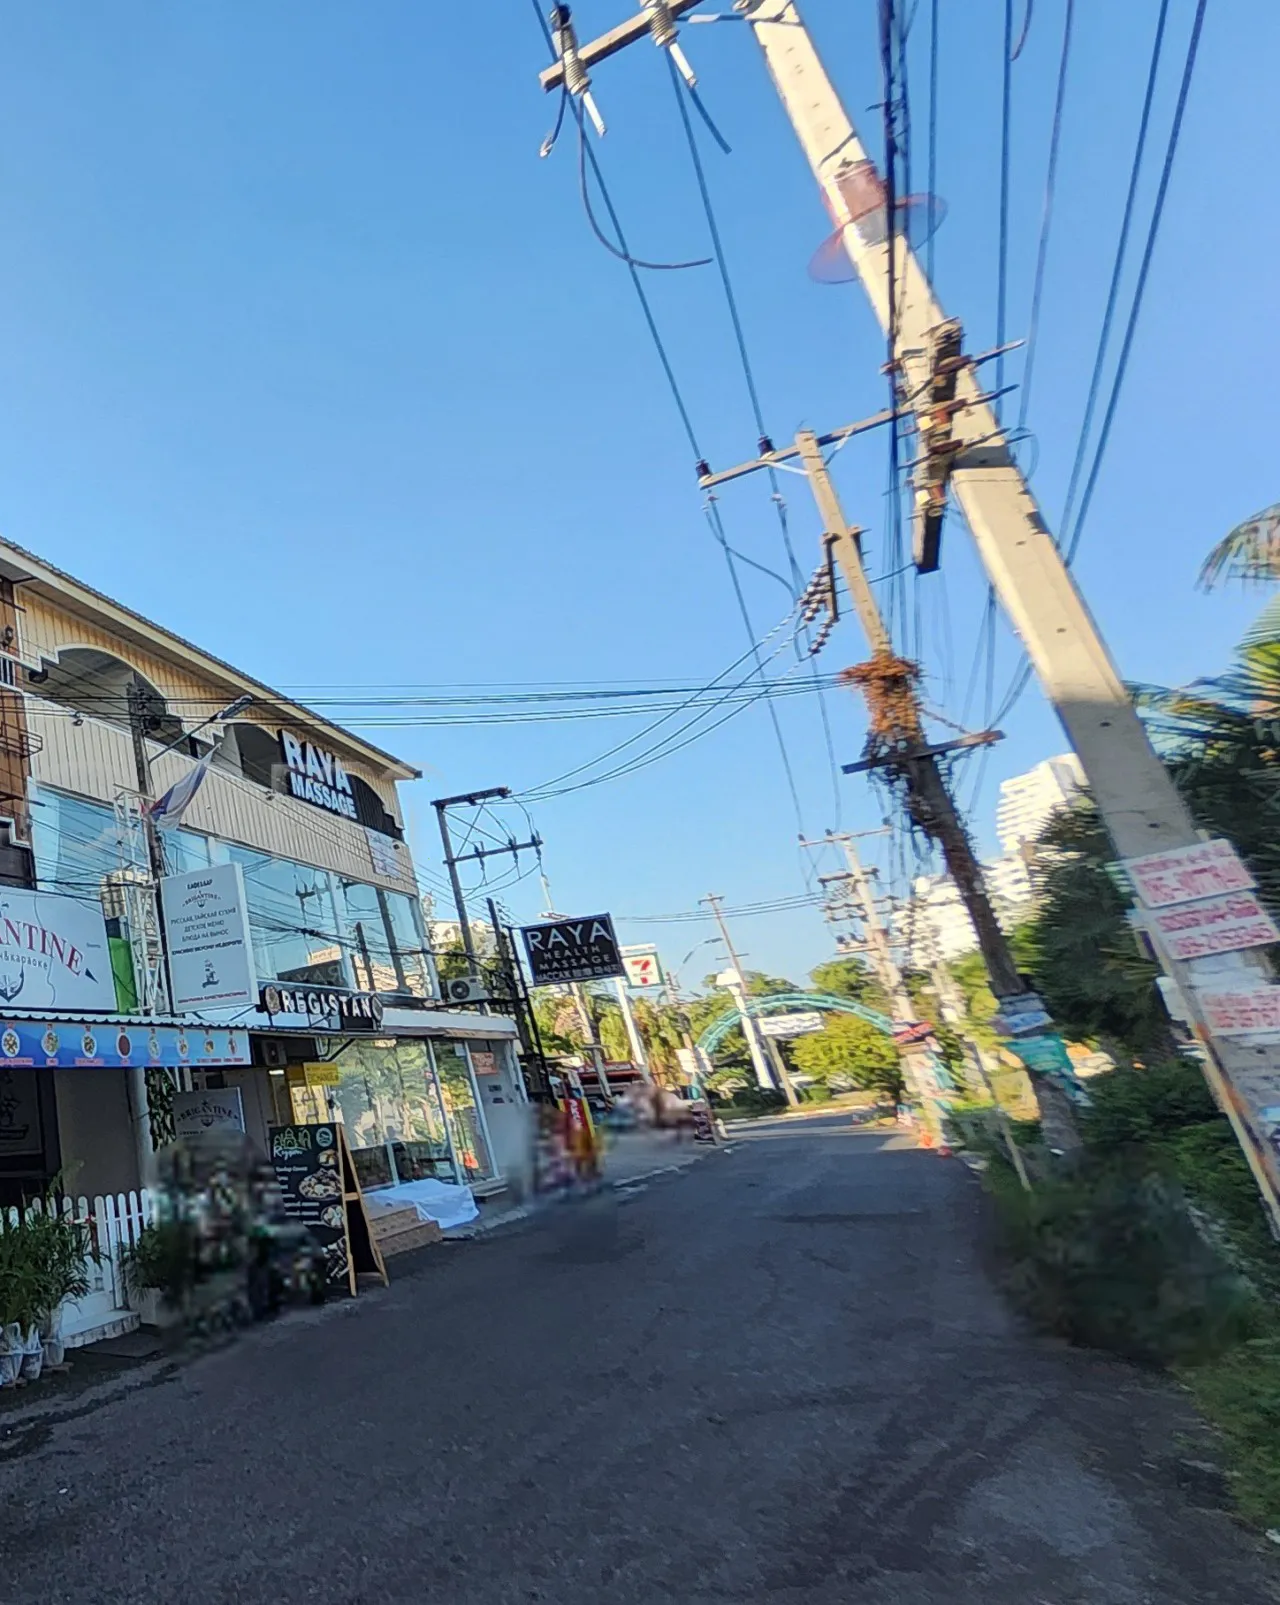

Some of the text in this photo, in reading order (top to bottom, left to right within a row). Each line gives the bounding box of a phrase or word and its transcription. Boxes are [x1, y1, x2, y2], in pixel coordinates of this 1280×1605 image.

[282, 729, 352, 795] RAYA
[290, 771, 358, 819] MASSAGE
[526, 921, 612, 952] RAYA
[540, 954, 611, 970] MASSAGE
[543, 945, 600, 960] HEALTH
[281, 990, 372, 1017] REGISTAN
